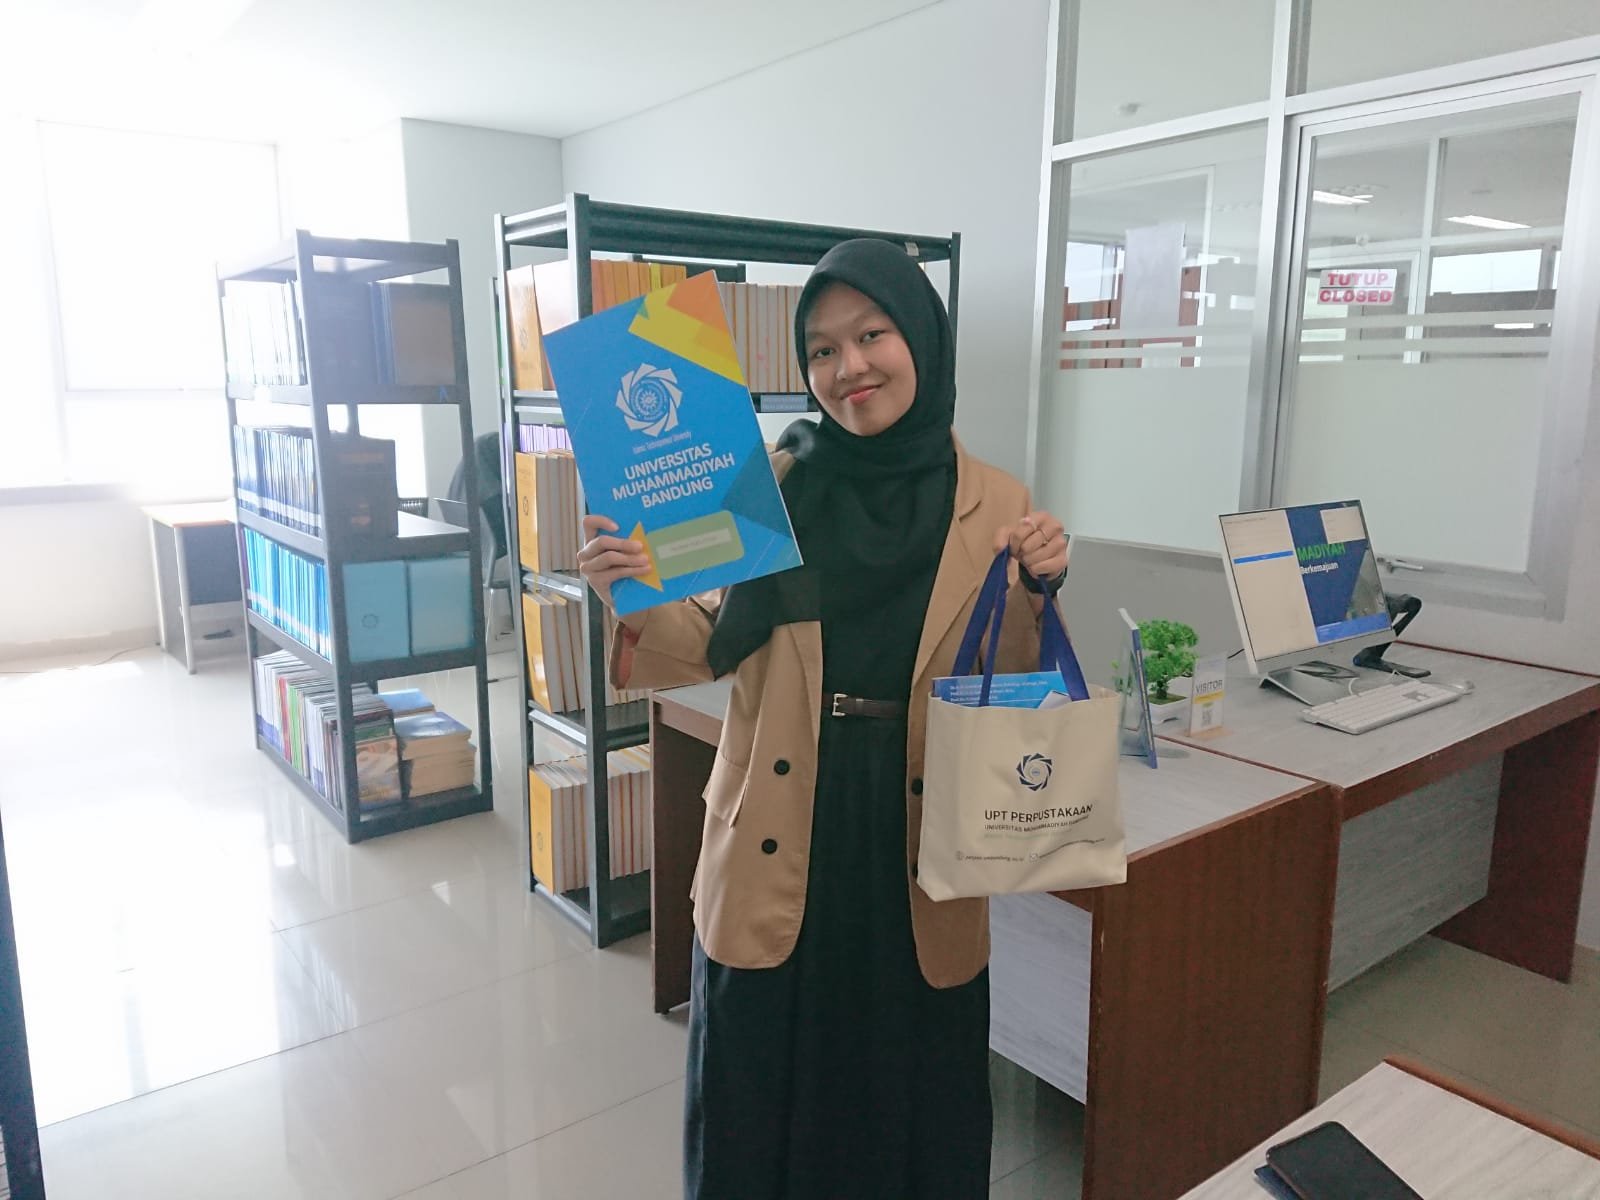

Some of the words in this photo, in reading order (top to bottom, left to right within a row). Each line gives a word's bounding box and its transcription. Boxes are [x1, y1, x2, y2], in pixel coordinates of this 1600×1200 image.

[1327, 272, 1389, 286] TUTUP
[1319, 289, 1393, 303] CLOSED
[624, 442, 713, 480] UNIVERSITAS
[612, 452, 736, 501] MUHAMMADIYAH
[641, 476, 714, 509] BANDUNG
[1195, 679, 1223, 694] VISITOR
[984, 809, 1009, 821] UPT
[1010, 803, 1094, 823] PERPUSTAKAAN
[984, 823, 1023, 832] UNIVERSITAS
